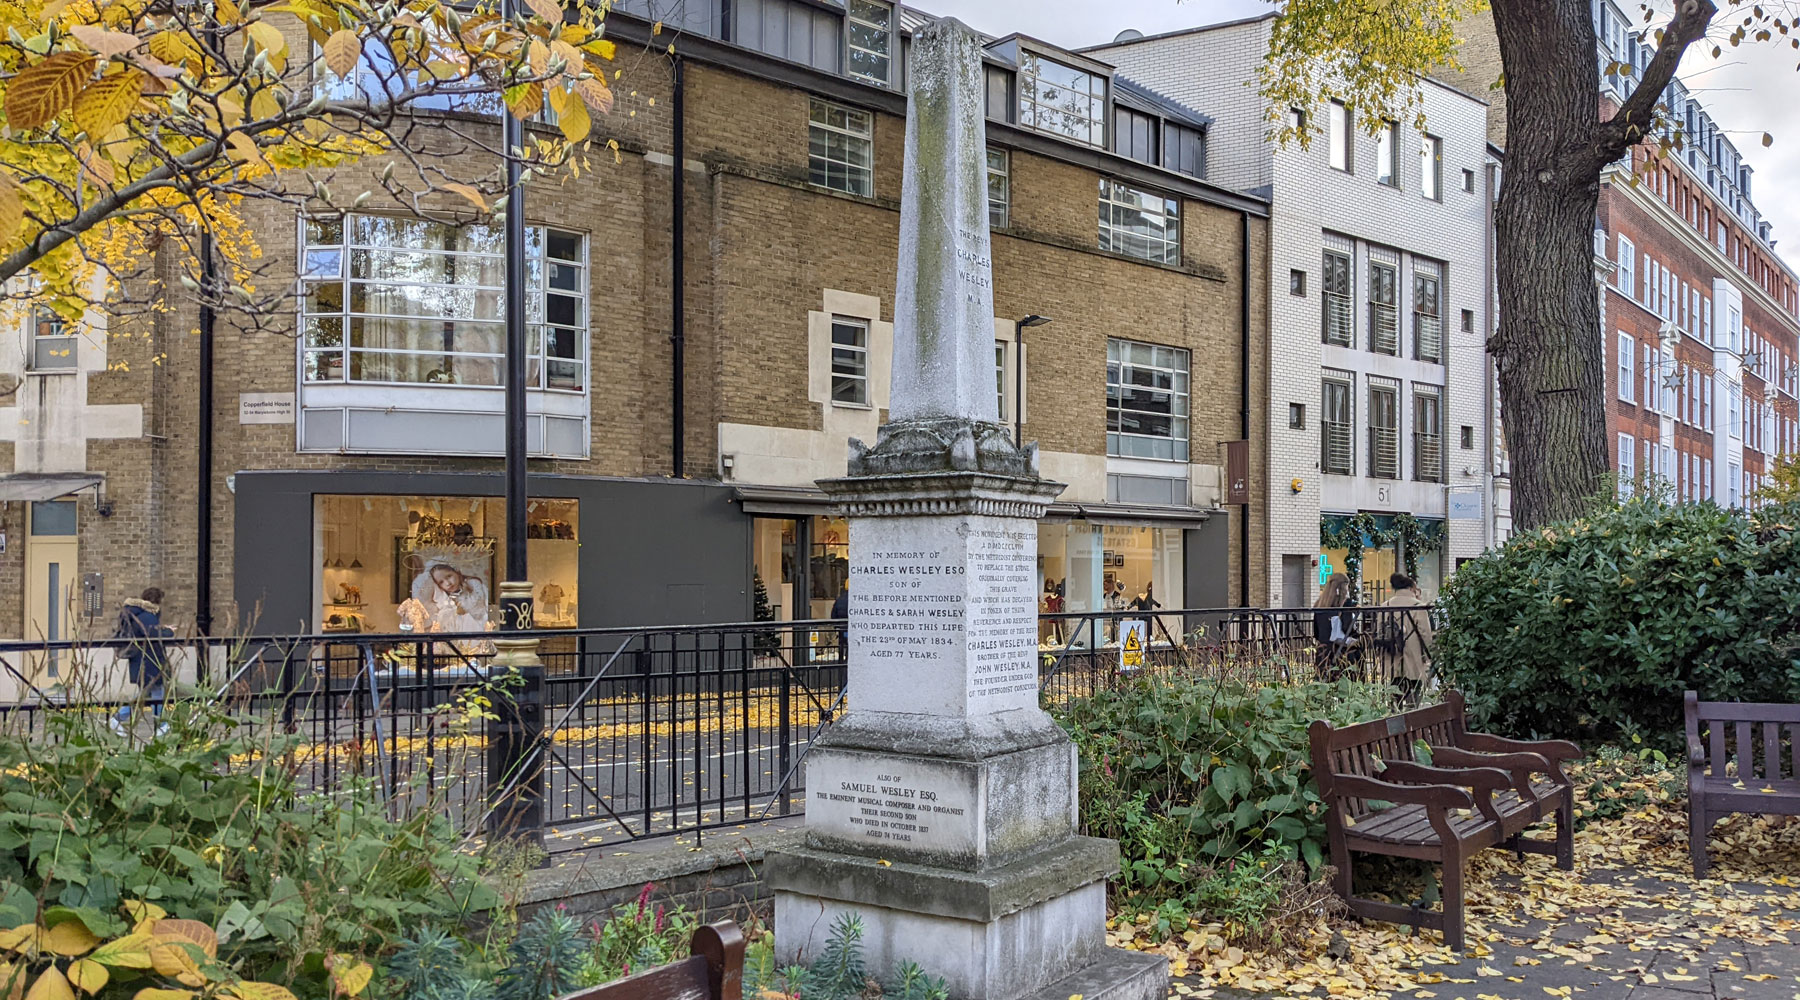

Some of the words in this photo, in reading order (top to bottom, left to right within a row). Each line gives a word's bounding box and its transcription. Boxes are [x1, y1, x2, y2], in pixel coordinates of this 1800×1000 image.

[960, 230, 970, 239] THE
[958, 248, 990, 268] CHARLES
[959, 270, 989, 288] WESLEY
[1378, 488, 1390, 502] 51
[851, 566, 895, 575] CHARLES
[899, 566, 941, 575] WESLEY
[849, 608, 886, 616] CHARLES
[896, 609, 924, 617] SARAH
[928, 609, 964, 617] WESLEY
[968, 640, 997, 650] CHARLES
[977, 653, 999, 661] BROTHER
[975, 665, 991, 674] JOHN
[985, 676, 1007, 684] FOUNDER
[988, 686, 1013, 695] METHODIST
[841, 782, 877, 794] SAMUEL
[881, 786, 916, 798] WESLEY
[816, 792, 828, 800] THE
[830, 793, 856, 803] EMINENT
[858, 797, 883, 806] MUSICAL
[885, 800, 915, 810] COMPOSER
[917, 804, 931, 812] AND
[933, 805, 964, 816] ORGANIST
[861, 808, 878, 816] THEIR
[880, 810, 903, 819] SECOND
[905, 812, 917, 821] SON
[865, 818, 880, 827] DIED
[890, 821, 916, 832] OCTOBER
[918, 824, 929, 833] 1837
[866, 830, 882, 838] AGED
[892, 833, 911, 842] YEARS
